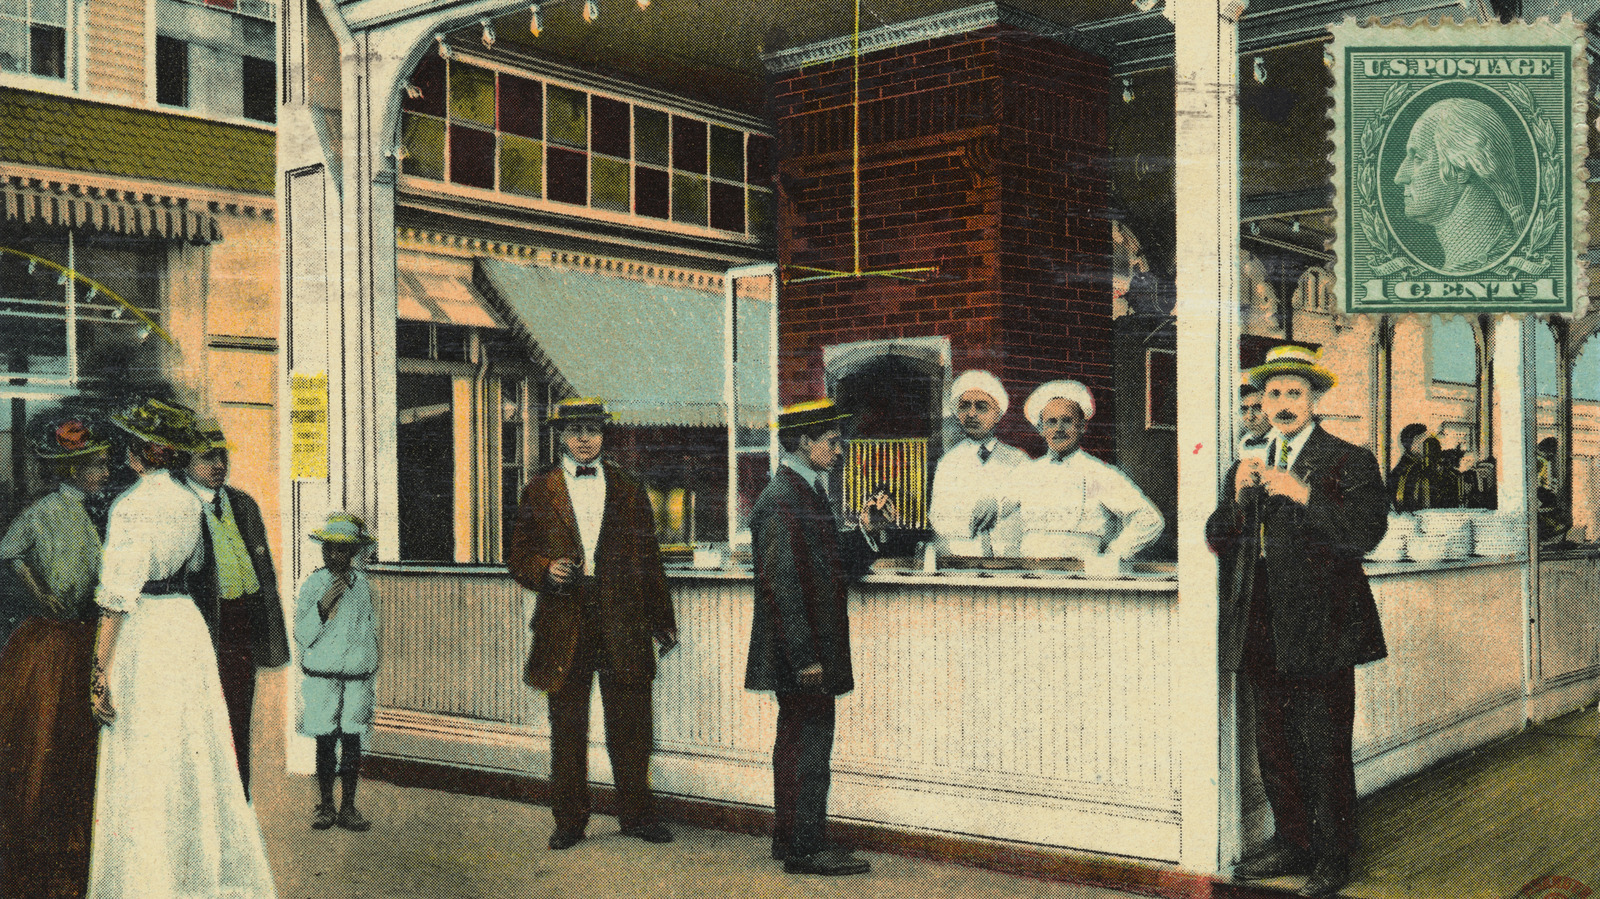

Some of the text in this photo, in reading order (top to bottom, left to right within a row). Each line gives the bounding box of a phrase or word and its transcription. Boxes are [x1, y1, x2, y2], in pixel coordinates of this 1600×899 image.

[1360, 279, 1560, 301] 1 CENT 1
